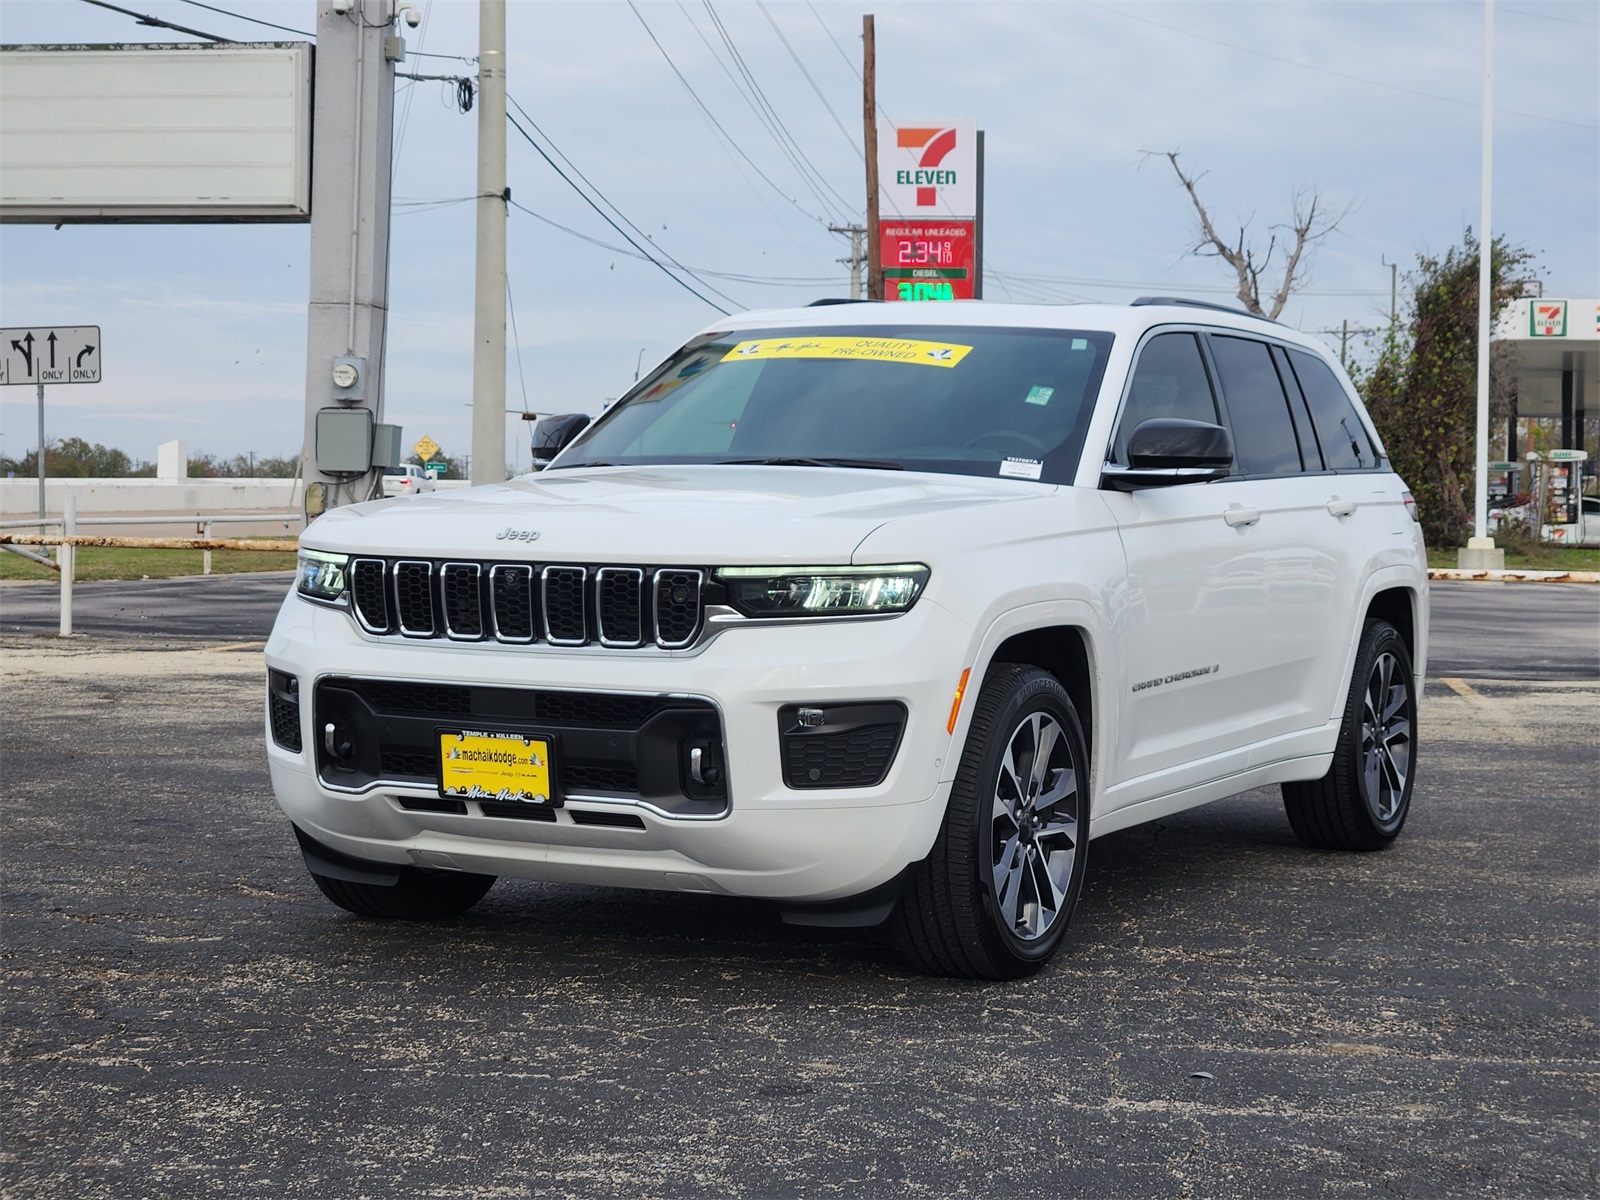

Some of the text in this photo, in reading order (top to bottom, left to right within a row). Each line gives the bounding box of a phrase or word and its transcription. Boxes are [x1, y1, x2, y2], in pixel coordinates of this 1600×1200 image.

[897, 170, 956, 184] ELEVEN
[886, 228, 966, 237] REGULAR UNLEADED
[899, 241, 941, 263] 2.34
[912, 269, 938, 277] DIESEL
[855, 340, 918, 350] QUALITY
[831, 347, 917, 359] PRE-OWNED
[42, 371, 64, 380] ONLY
[73, 369, 96, 379] ONLY
[496, 527, 541, 543] Jeep
[1165, 665, 1211, 684] CHEROKEE
[461, 730, 488, 738] TEMPLE
[462, 749, 529, 767] machaikdodge.com
[466, 785, 492, 799] Mac
